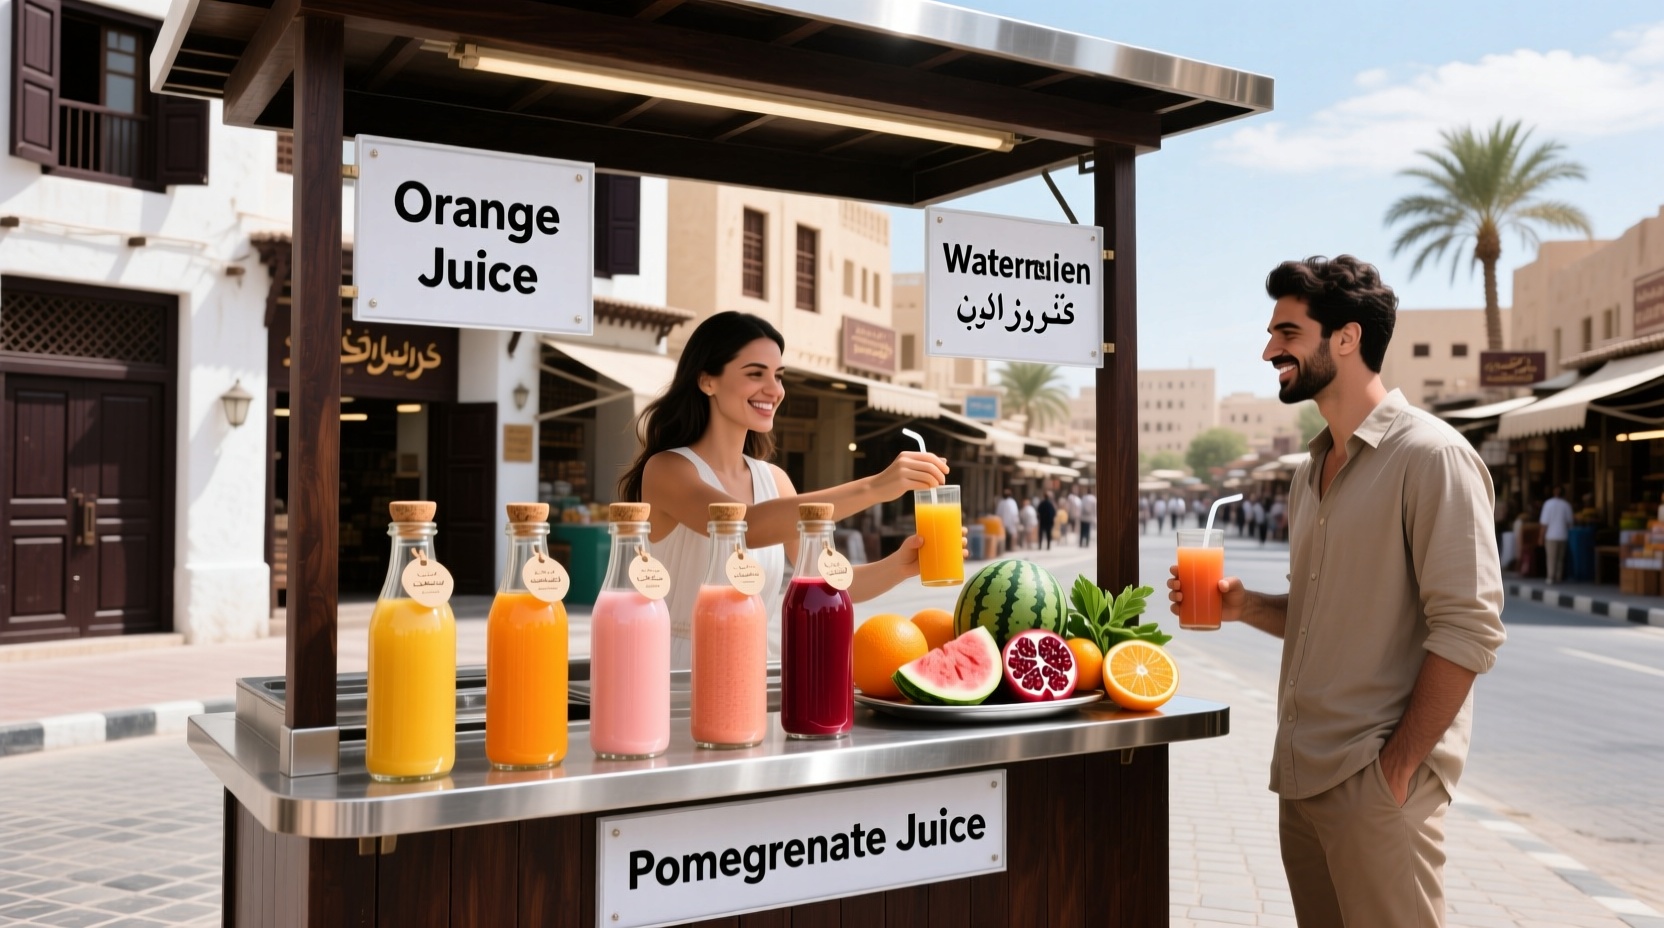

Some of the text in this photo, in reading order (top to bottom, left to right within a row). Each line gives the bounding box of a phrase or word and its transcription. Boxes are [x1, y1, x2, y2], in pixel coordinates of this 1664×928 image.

[395, 181, 560, 244] Orange
[417, 247, 538, 295] Juice
[629, 807, 986, 890] Pomegrenate Juice
